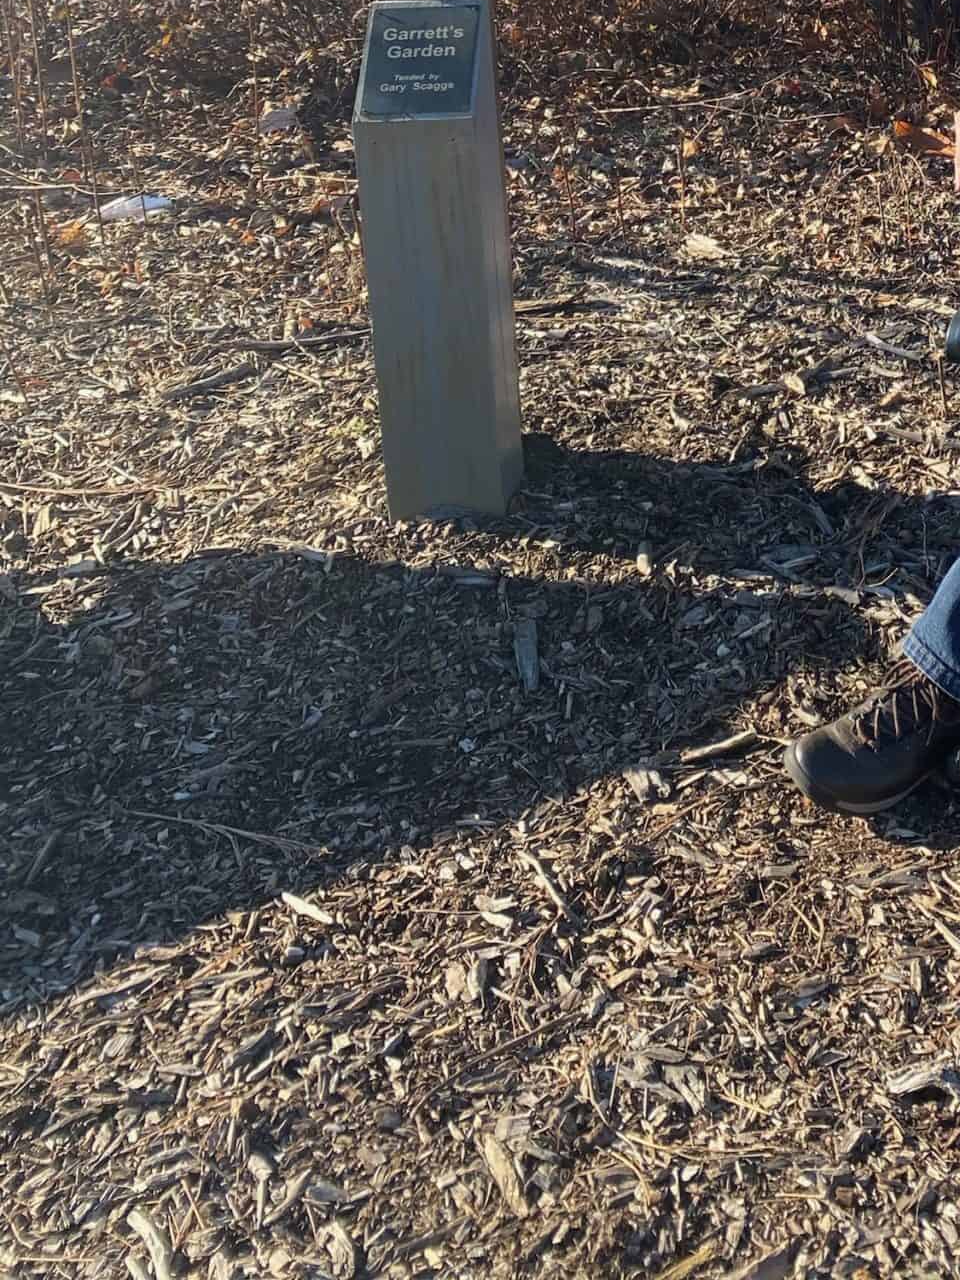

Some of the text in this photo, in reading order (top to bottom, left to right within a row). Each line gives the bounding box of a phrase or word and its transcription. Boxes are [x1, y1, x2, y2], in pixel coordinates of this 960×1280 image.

[383, 26, 465, 41] Garrett's
[387, 44, 456, 59] Garden
[380, 81, 455, 93] Gary Scaggs
